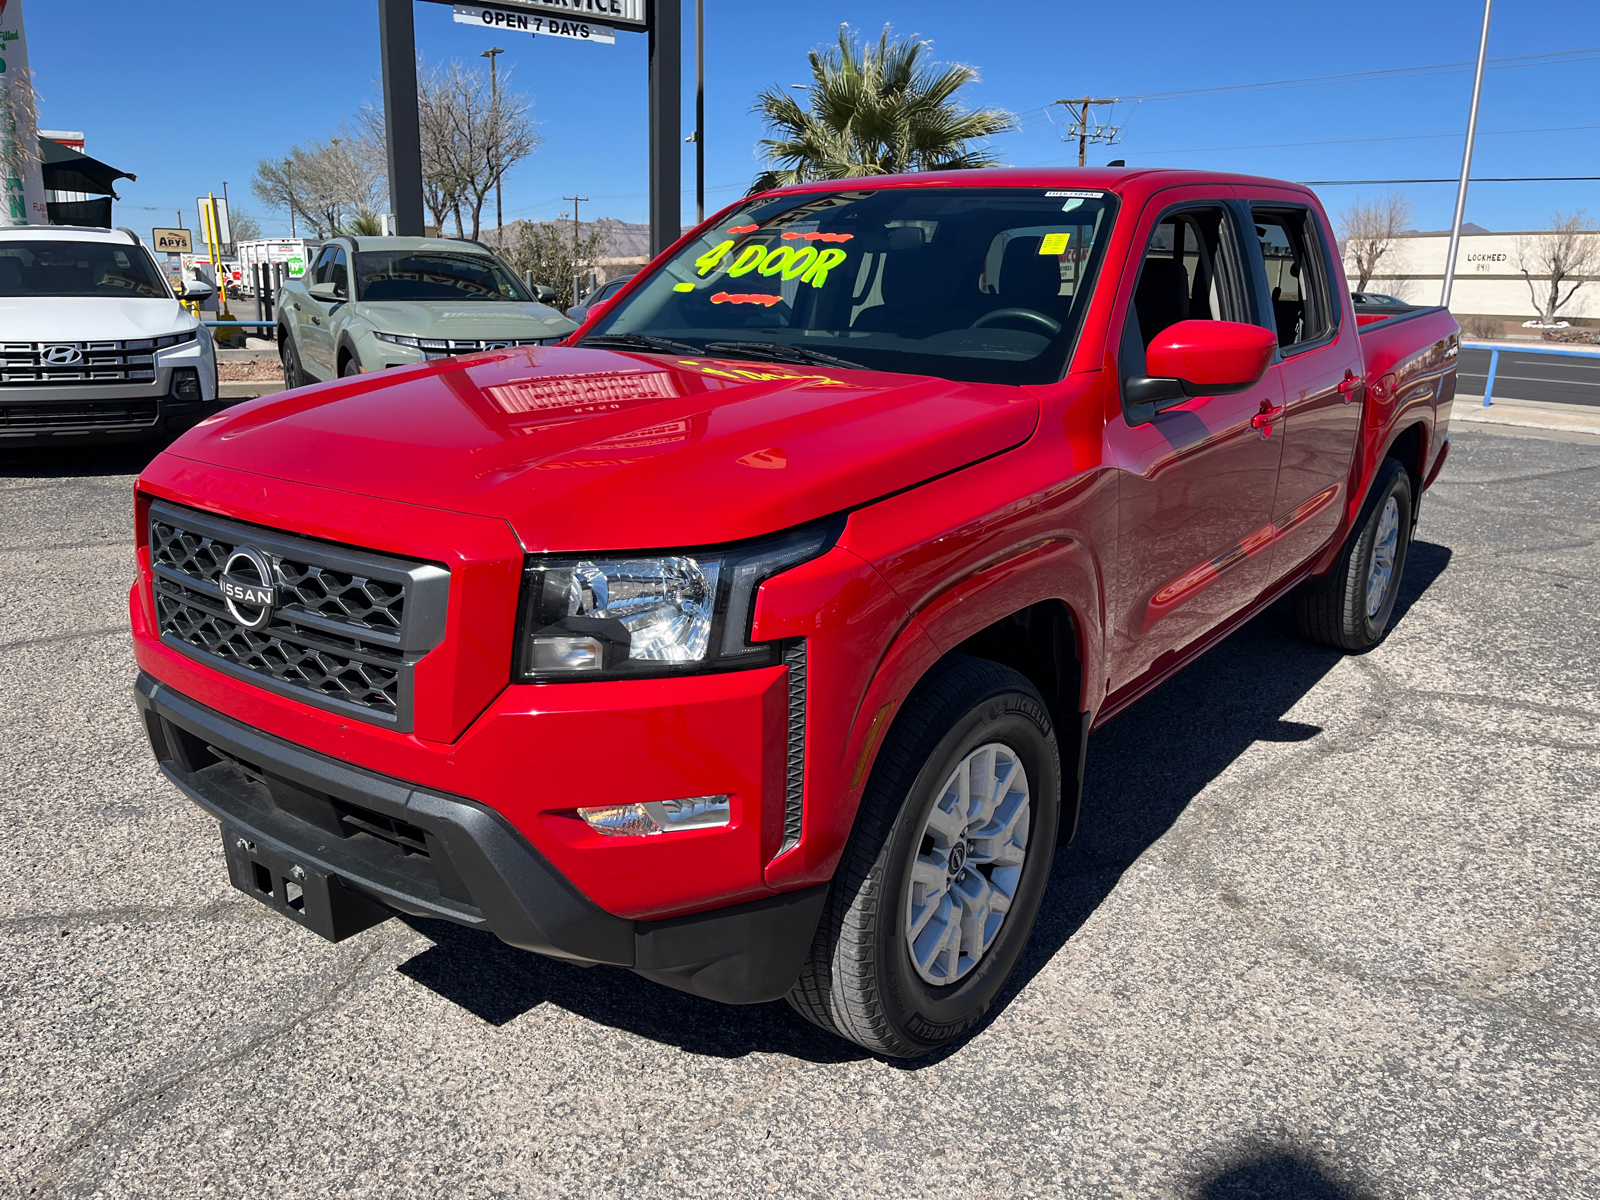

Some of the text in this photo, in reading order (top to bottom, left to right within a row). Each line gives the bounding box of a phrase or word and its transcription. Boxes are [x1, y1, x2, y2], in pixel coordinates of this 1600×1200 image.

[530, 0, 621, 14] VICE
[482, 10, 590, 38] OPEN 7 DAYS
[695, 240, 847, 288] 4 DOOR
[1467, 253, 1507, 262] LOCKHEED
[1475, 263, 1490, 272] 8411
[171, 468, 406, 532] FRONTIER
[219, 580, 271, 604] NISSAN
[1006, 697, 1050, 733] MICHELIN
[888, 970, 906, 1017] PRIMACY
[907, 1015, 967, 1041] MICHELIN
